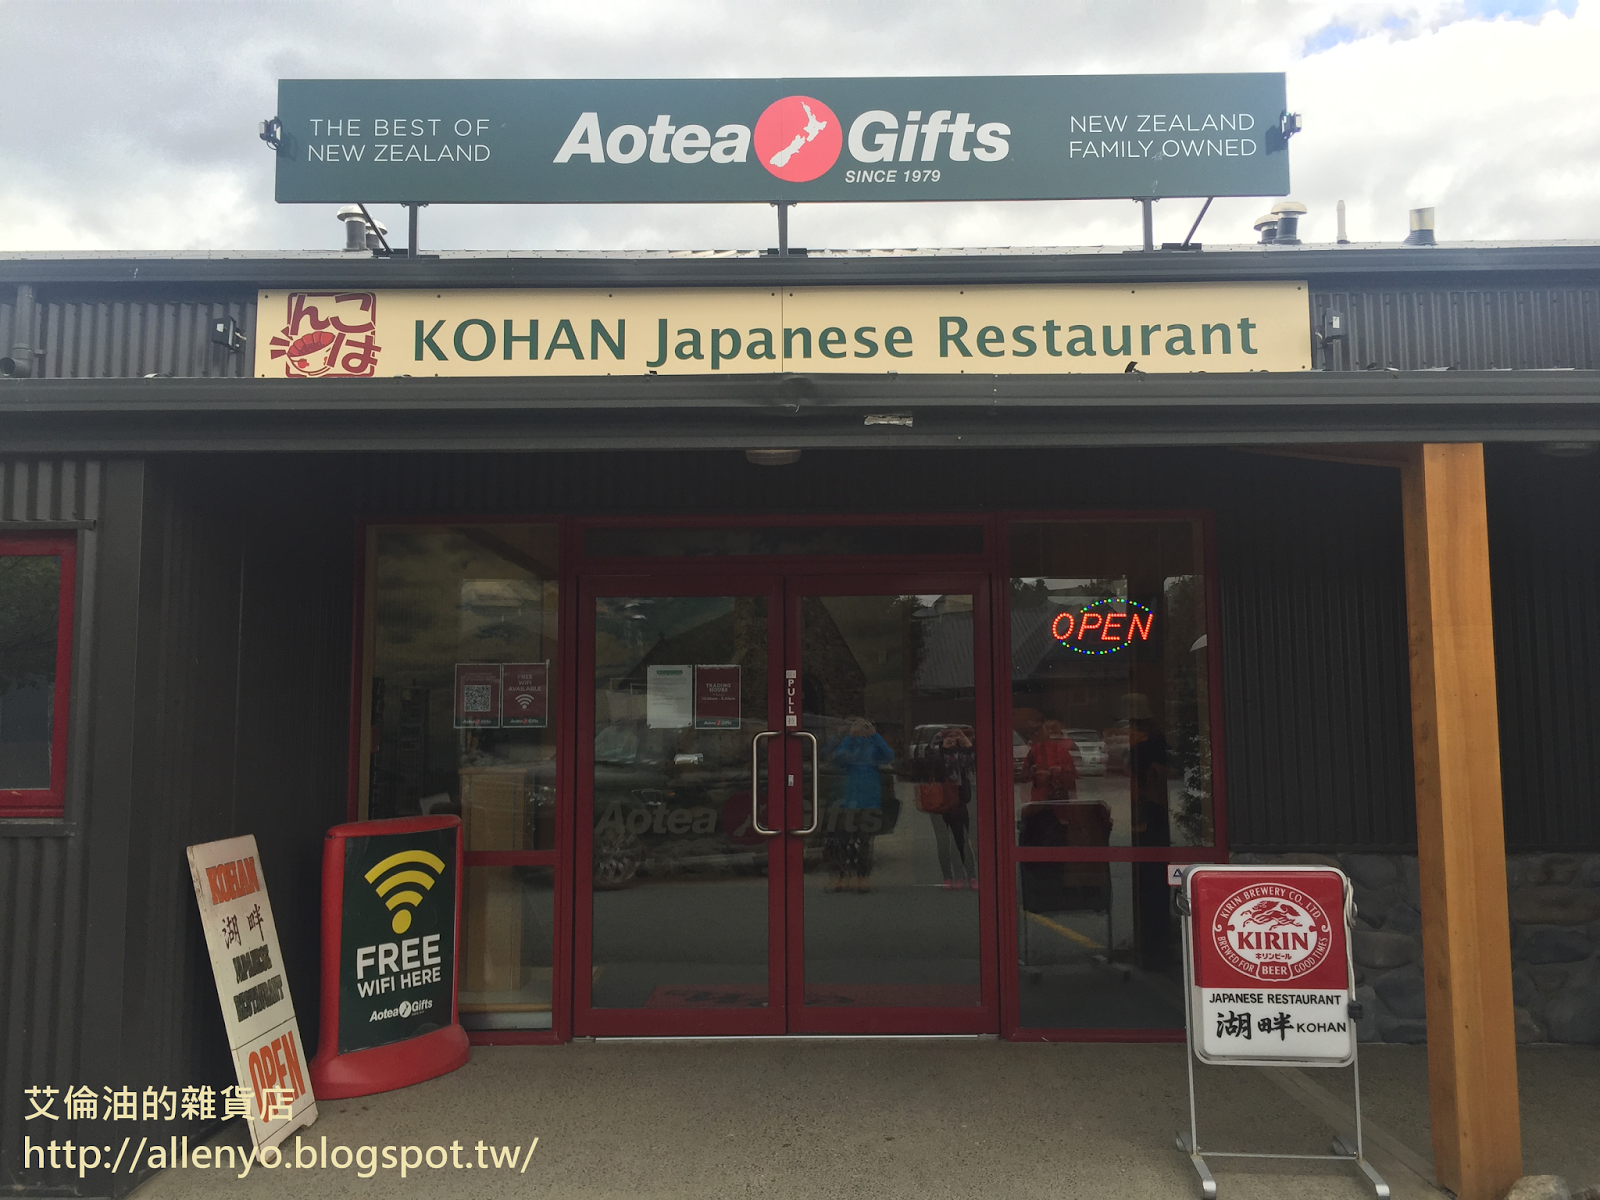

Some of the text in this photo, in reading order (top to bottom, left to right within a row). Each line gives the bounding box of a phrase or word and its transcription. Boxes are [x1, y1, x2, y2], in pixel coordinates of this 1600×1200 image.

[309, 118, 490, 137] THE BEST OF
[553, 109, 1012, 165] Aotea Gifts
[1069, 113, 1255, 133] NEW ZEALAND
[308, 144, 491, 162] NEW ZEALAND
[1069, 138, 1257, 159] FAMILY OWNED
[844, 169, 941, 184] SINCE 1979
[414, 316, 1259, 370] KOHAN Japanese Restaurant
[1052, 612, 1154, 641] OPEN
[787, 679, 795, 714] PULL
[595, 800, 718, 835] Aotea
[206, 856, 260, 905] KOHAN
[1220, 896, 1242, 919] KIRIN
[1243, 886, 1286, 900] BREWERY
[222, 903, 265, 949] 湖畔
[1237, 931, 1309, 951] KIRIN
[356, 933, 441, 980] FREE
[1217, 936, 1255, 973] BREWED FOR
[1261, 965, 1288, 975] BEER
[1294, 937, 1329, 974] GOOD TIMES
[357, 966, 441, 998] WIFI HERE
[369, 999, 433, 1022] Aotea Gifts
[1209, 993, 1341, 1005] JAPANESE RESTAURANT
[1216, 1010, 1347, 1041] 湖畔 KOHAN
[249, 1030, 306, 1123] OPEN
